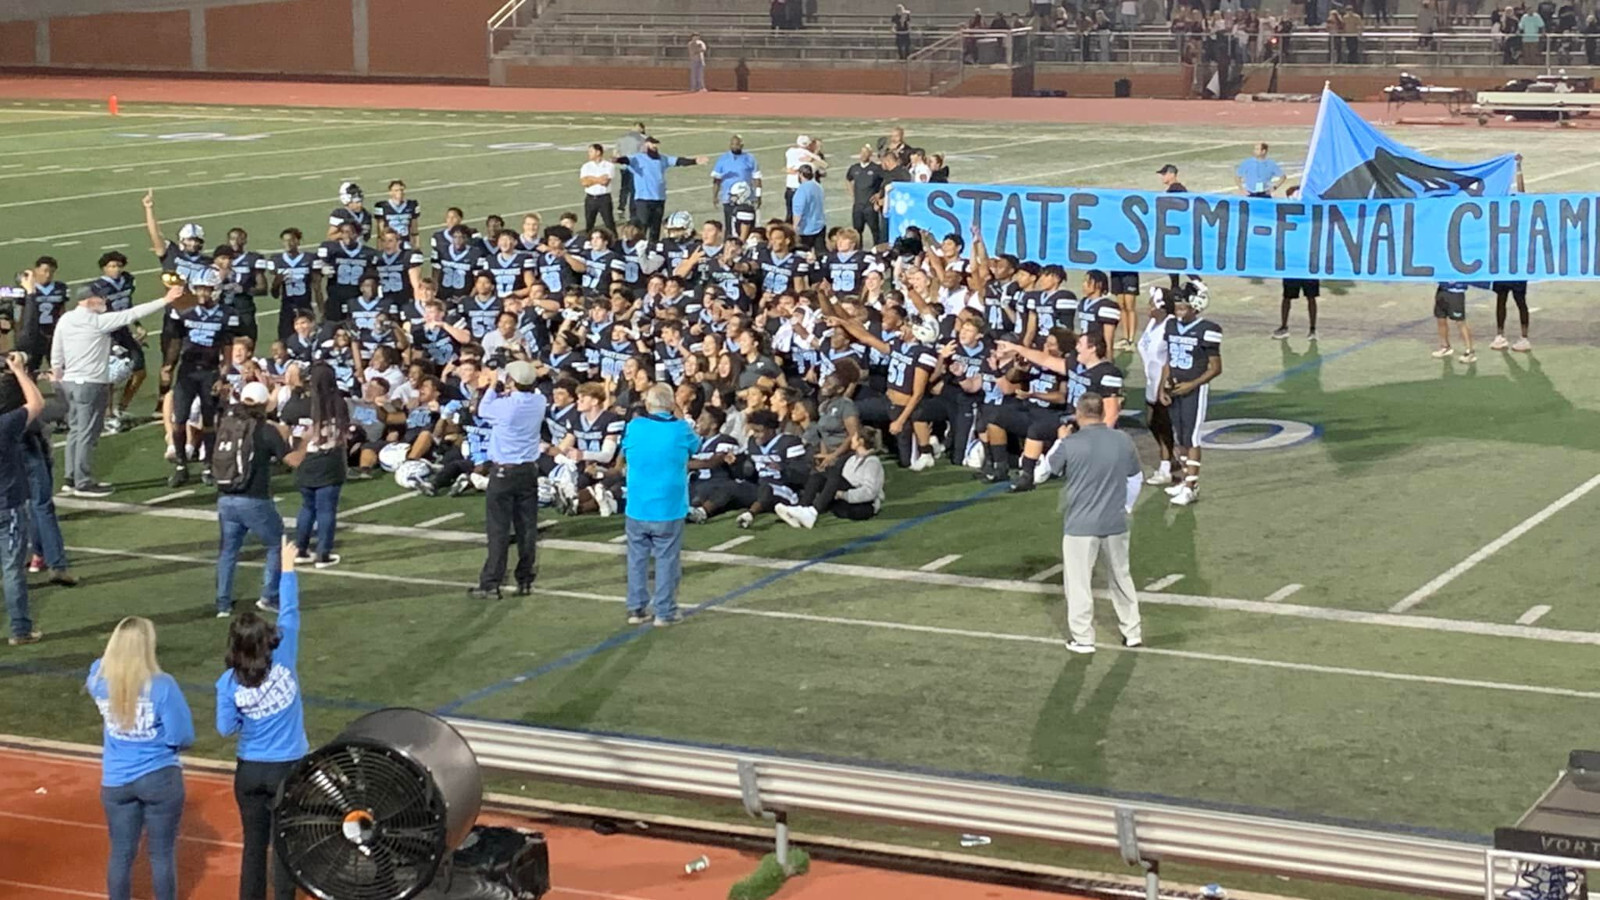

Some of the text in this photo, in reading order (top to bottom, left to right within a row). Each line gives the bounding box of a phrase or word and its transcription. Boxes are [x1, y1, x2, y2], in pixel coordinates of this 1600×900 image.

[927, 189, 1600, 276] STATE SEMI-FINAL CHAM
[39, 302, 54, 324] 2
[887, 358, 906, 387] 51
